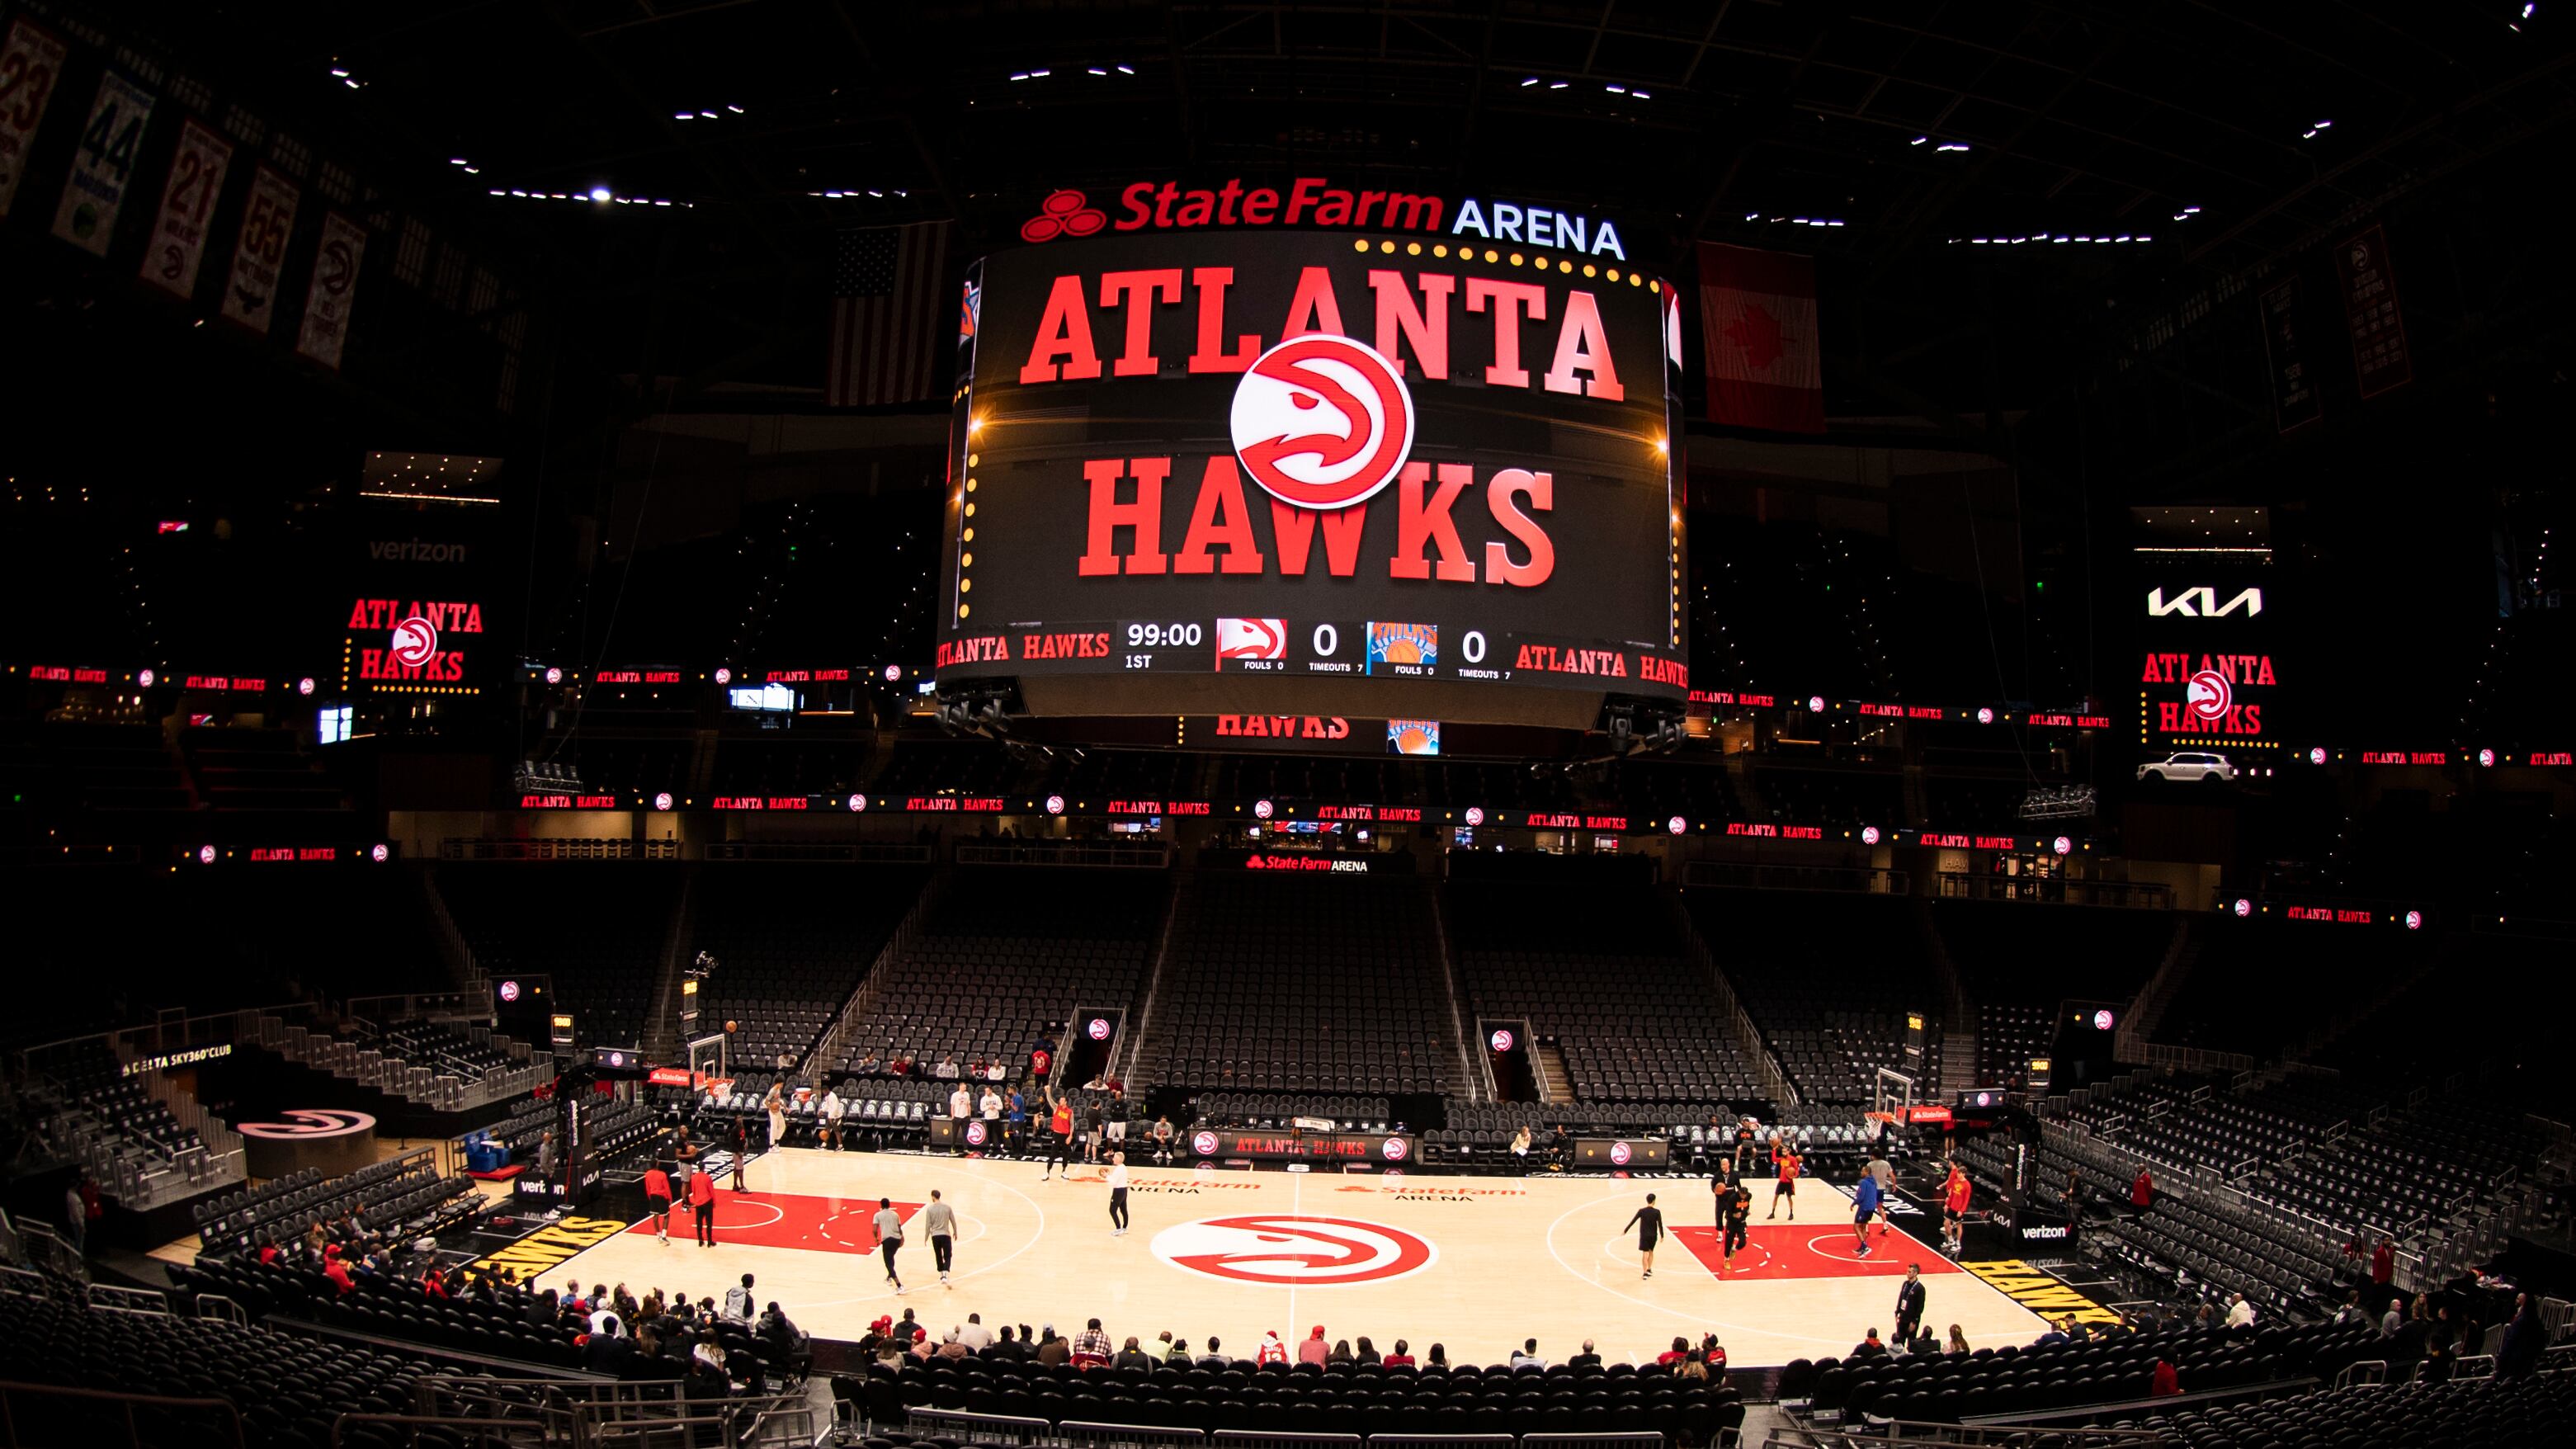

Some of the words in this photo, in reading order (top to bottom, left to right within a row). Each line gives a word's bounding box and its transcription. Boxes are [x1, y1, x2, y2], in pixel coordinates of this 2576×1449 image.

[82, 101, 141, 182] 44
[169, 150, 217, 224] 21
[245, 194, 290, 265] 55
[1453, 201, 1625, 260] ARENA
[1020, 267, 1625, 402] ATLANTA
[1079, 456, 1555, 588] HAWKS
[370, 537, 465, 563] verizon
[2149, 587, 2261, 617] KIA
[348, 599, 483, 634] ATLANTA
[1127, 624, 1202, 647] 99:00
[1313, 624, 1338, 656] 0
[1023, 633, 1109, 659] HAWKS
[1462, 631, 1486, 663] 0
[360, 647, 464, 681] HAWKS
[1125, 655, 1152, 669] 1ST
[1244, 661, 1271, 670] FOULS
[1277, 661, 1284, 671] 0
[1309, 663, 1352, 672] TIMEOUTS
[1357, 663, 1364, 673] 7
[1516, 644, 1627, 677] ATLANTA
[597, 672, 640, 682] ATLANTA
[645, 673, 680, 683] HAWKS
[767, 671, 809, 682] ATLANTA
[815, 670, 848, 681] HAWKS
[1395, 664, 1422, 675] FOULS
[1427, 667, 1434, 676] 0
[1459, 668, 1499, 679] TIMEOUTS
[1504, 671, 1512, 681] 7
[2145, 653, 2276, 686] ATLANTA
[1689, 690, 1734, 704] ATLANTA
[1739, 694, 1774, 706] HAWKS
[1860, 704, 1904, 717] ATLANTA
[1908, 706, 1942, 720] HAWKS
[2159, 701, 2261, 734] HAWKS
[2029, 715, 2073, 726] ATLANTA
[2078, 716, 2109, 728] HAWKS
[2363, 753, 2406, 764] ATLANTA
[2412, 753, 2445, 764] HAWKS
[521, 795, 571, 808] ATLANTA
[577, 795, 615, 808] HAWKS
[713, 797, 763, 809] ATLANTA
[769, 798, 807, 809] HAWKS
[906, 798, 957, 810] ATLANTA
[964, 799, 1003, 811] HAWKS
[1108, 801, 1162, 814] ATLANTA
[1168, 802, 1210, 814] HAWKS
[1318, 806, 1373, 819] ATLANTA
[1379, 808, 1421, 821] HAWKS
[1527, 814, 1580, 827] ATLANTA
[1587, 816, 1626, 829] HAWKS
[1726, 824, 1777, 837] ATLANTA
[1783, 825, 1821, 839] HAWKS
[1920, 833, 1970, 847] ATLANTA
[1975, 837, 2013, 849] HAWKS
[251, 848, 295, 861] ATLANTA
[300, 848, 335, 860] HAWKS
[1331, 861, 1367, 872] ARENA
[2288, 907, 2333, 920] ATLANTA
[2338, 910, 2371, 923] HAWKS
[1236, 1137, 1305, 1154] ATLANTA
[2022, 1225, 2066, 1239] verizon
[1957, 1259, 2135, 1337] HAWK
